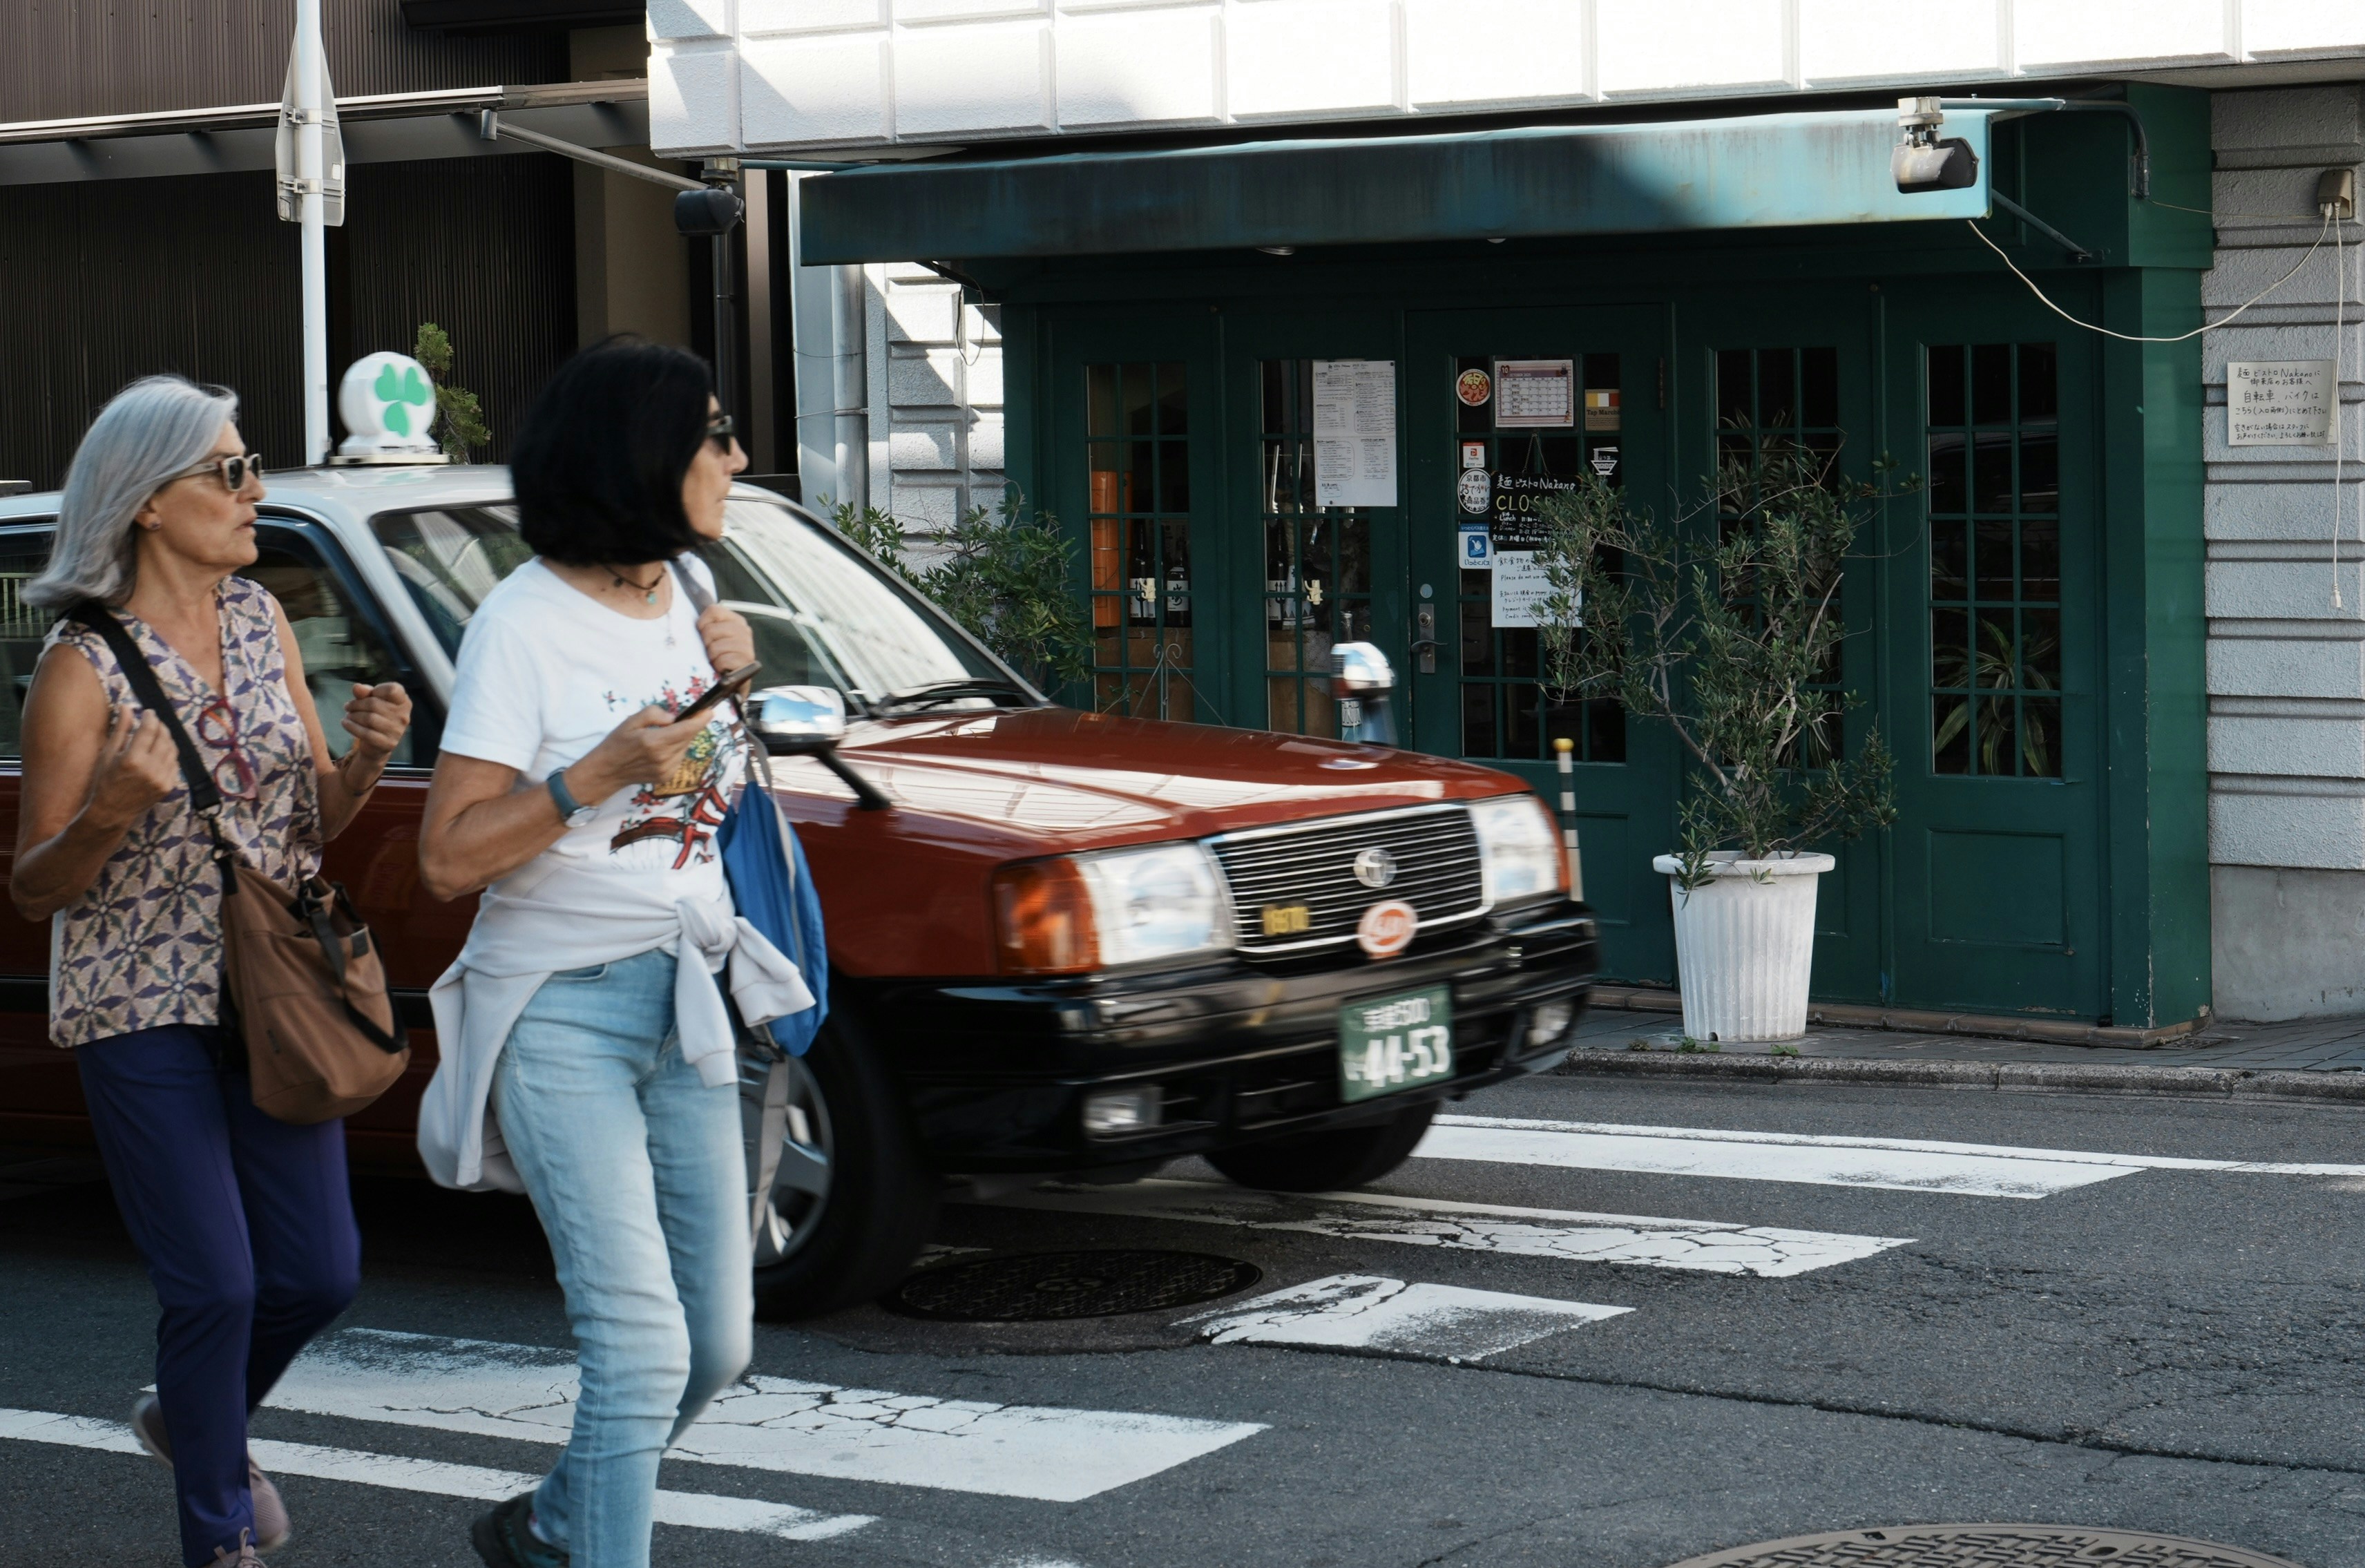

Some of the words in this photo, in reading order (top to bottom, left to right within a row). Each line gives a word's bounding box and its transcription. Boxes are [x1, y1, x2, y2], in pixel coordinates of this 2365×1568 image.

[1466, 474, 1486, 482] 京都市
[1496, 473, 1513, 490] 麺
[1515, 477, 1538, 489] ビストロ
[1540, 477, 1576, 490] Nakano
[1499, 513, 1516, 522] Lunch
[1363, 1025, 1451, 1088] 44-53
